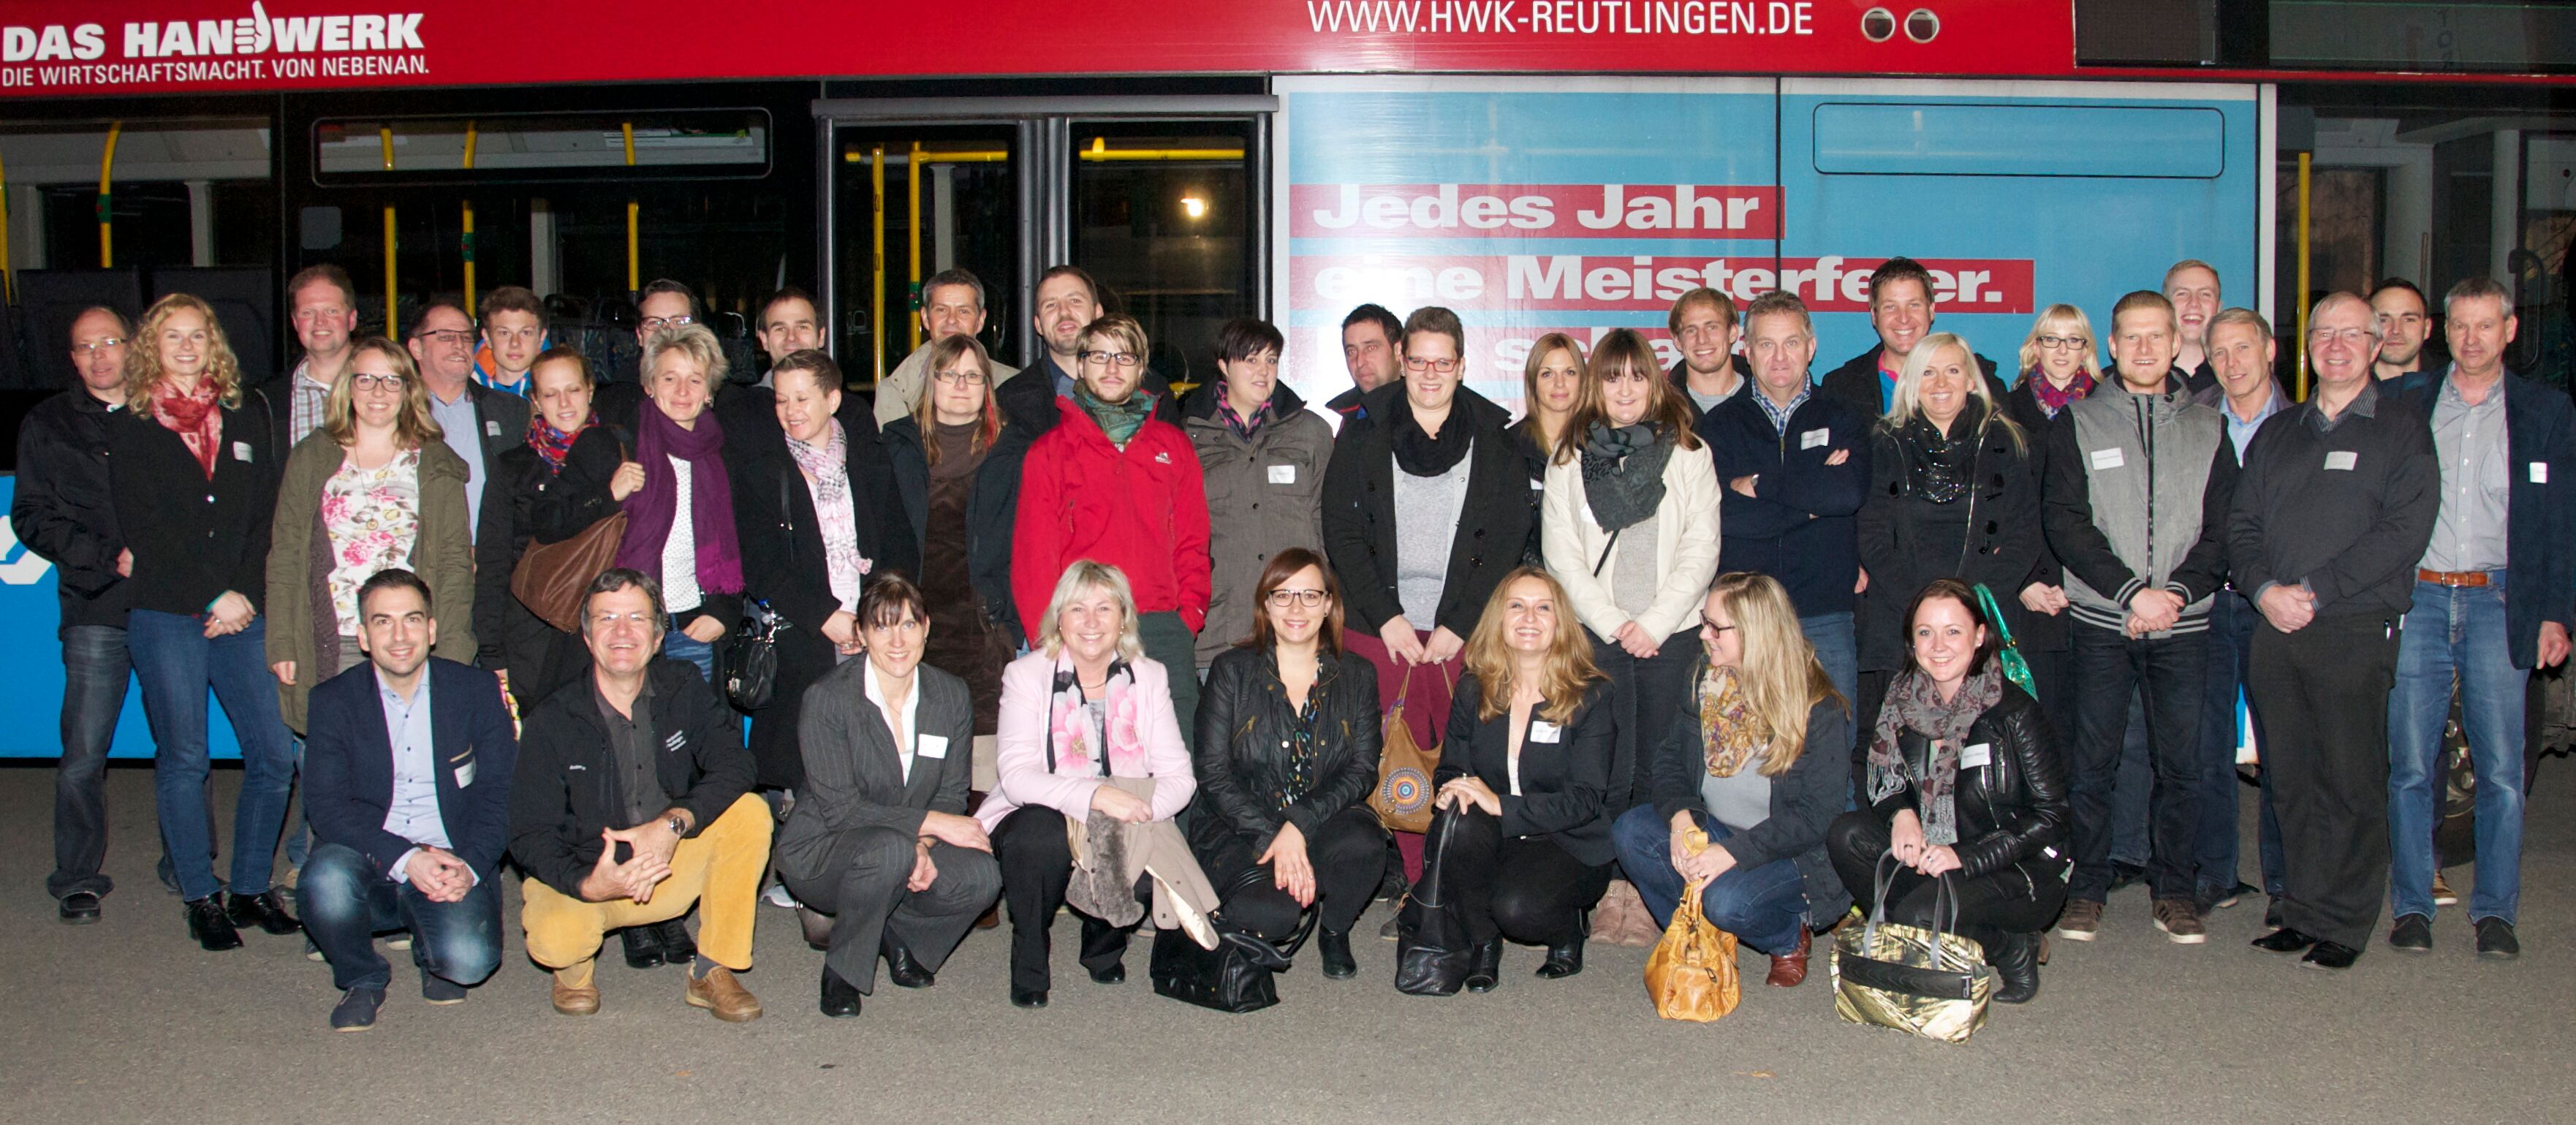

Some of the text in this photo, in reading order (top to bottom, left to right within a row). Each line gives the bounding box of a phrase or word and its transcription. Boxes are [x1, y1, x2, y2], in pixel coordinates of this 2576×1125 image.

[1307, 0, 1813, 34] WWW.HWK-REUTLINGEN.DE
[3, 23, 105, 61] DAS
[2, 55, 430, 87] DIE WIRTSCHAFTSMACHT. VON NEBENAN.
[1313, 183, 1759, 230] Jedes Jahr
[1314, 255, 2002, 303] eine Meisterfeer.
